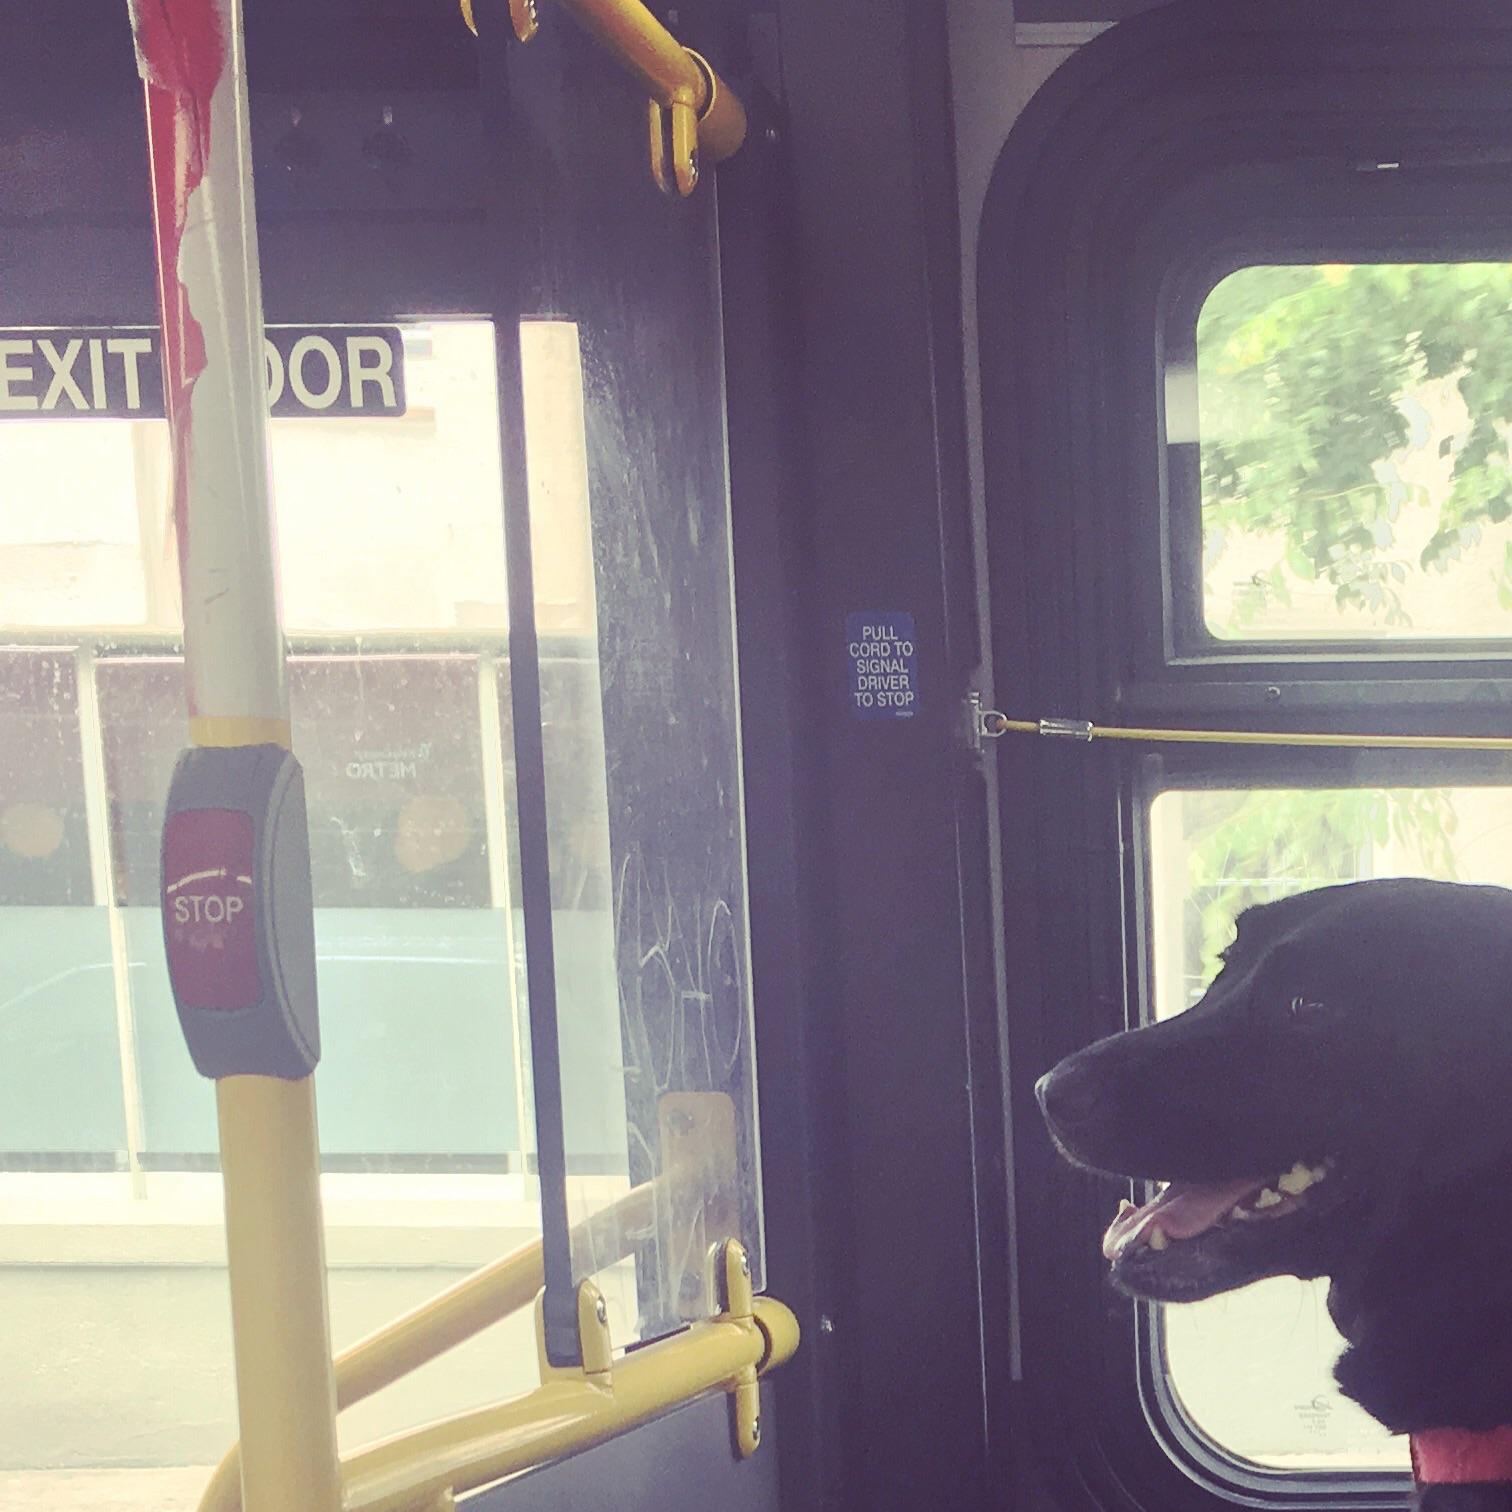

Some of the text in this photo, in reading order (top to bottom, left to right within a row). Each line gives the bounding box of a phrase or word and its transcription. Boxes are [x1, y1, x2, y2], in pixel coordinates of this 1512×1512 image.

[0, 338, 152, 410] EXIT
[863, 625, 898, 640] PULL
[849, 640, 914, 657] CORD TO
[856, 658, 909, 673] SIGNAL
[858, 675, 909, 690] DRIVER
[853, 691, 914, 707] TO STOP
[175, 894, 244, 924] STOP
